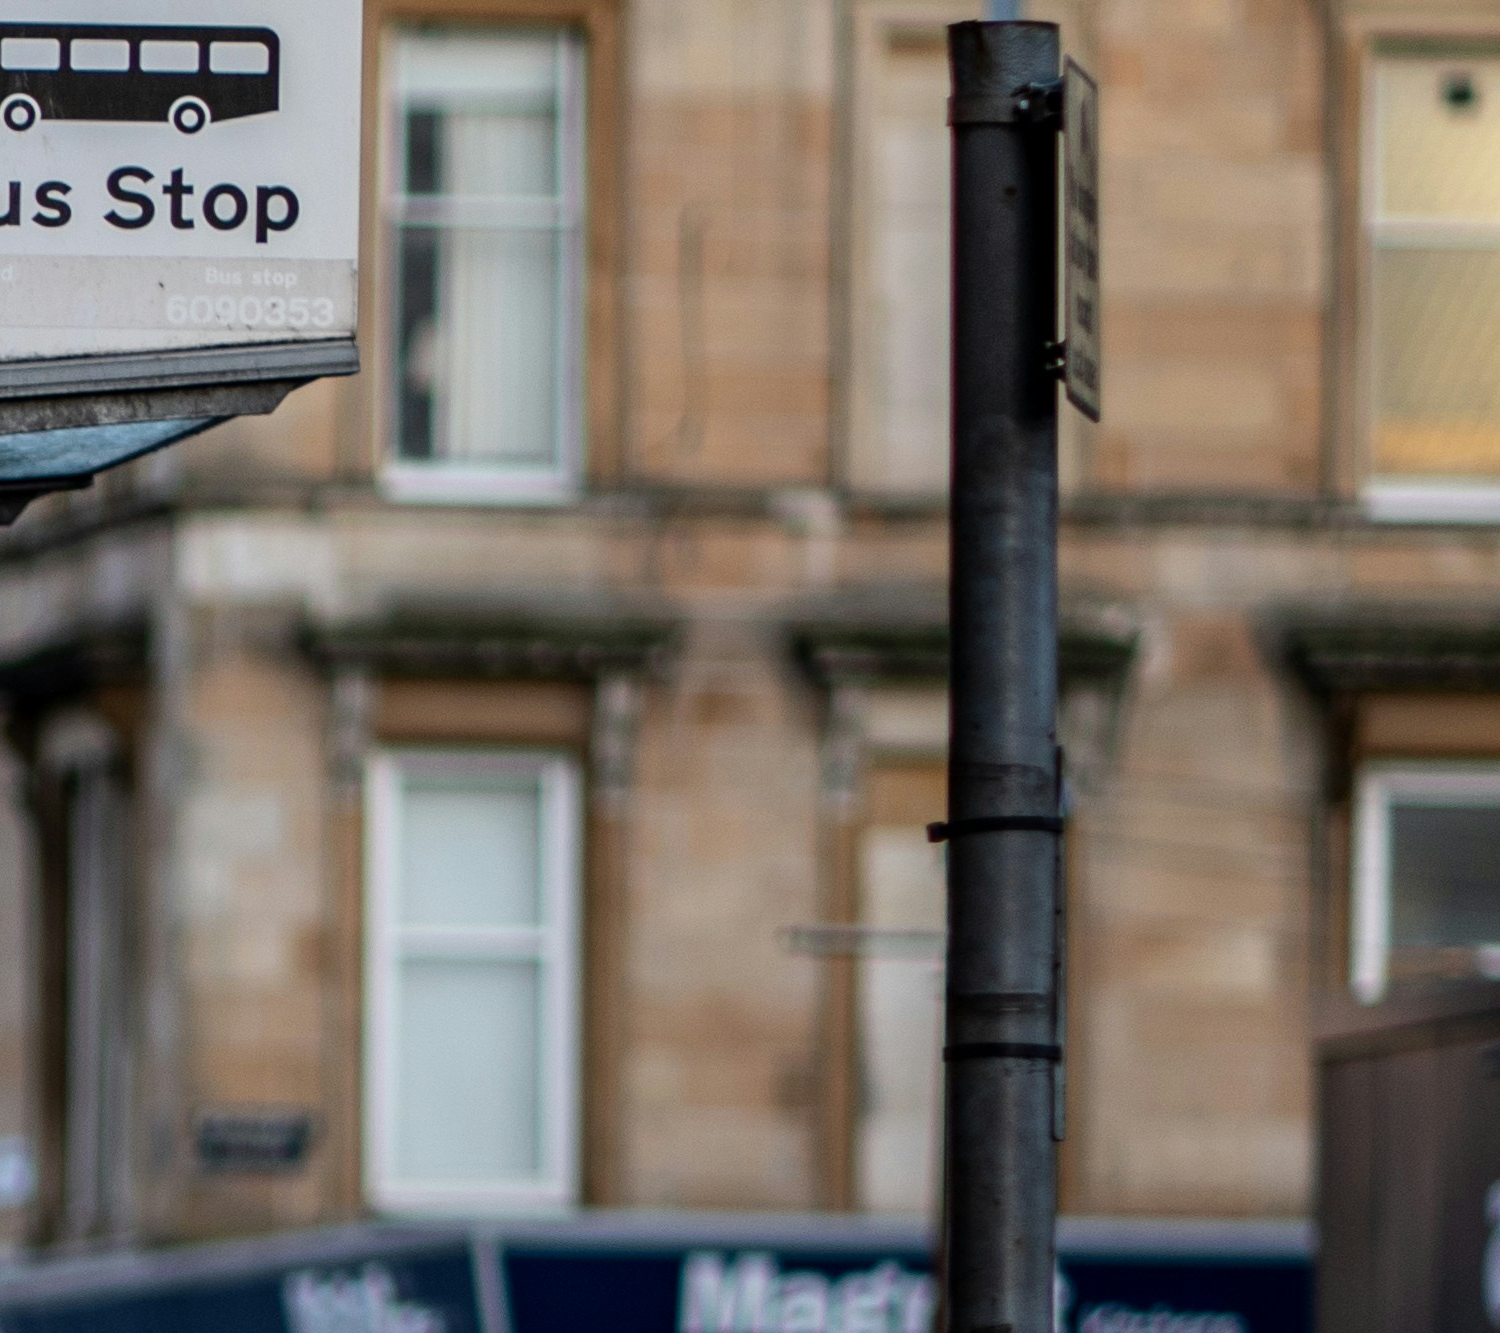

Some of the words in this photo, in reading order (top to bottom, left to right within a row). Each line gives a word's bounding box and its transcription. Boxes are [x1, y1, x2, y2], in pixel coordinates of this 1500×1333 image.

[102, 165, 301, 244] Stop
[204, 267, 243, 286] Bus
[251, 268, 300, 287] stop
[165, 294, 335, 327] 6090353
